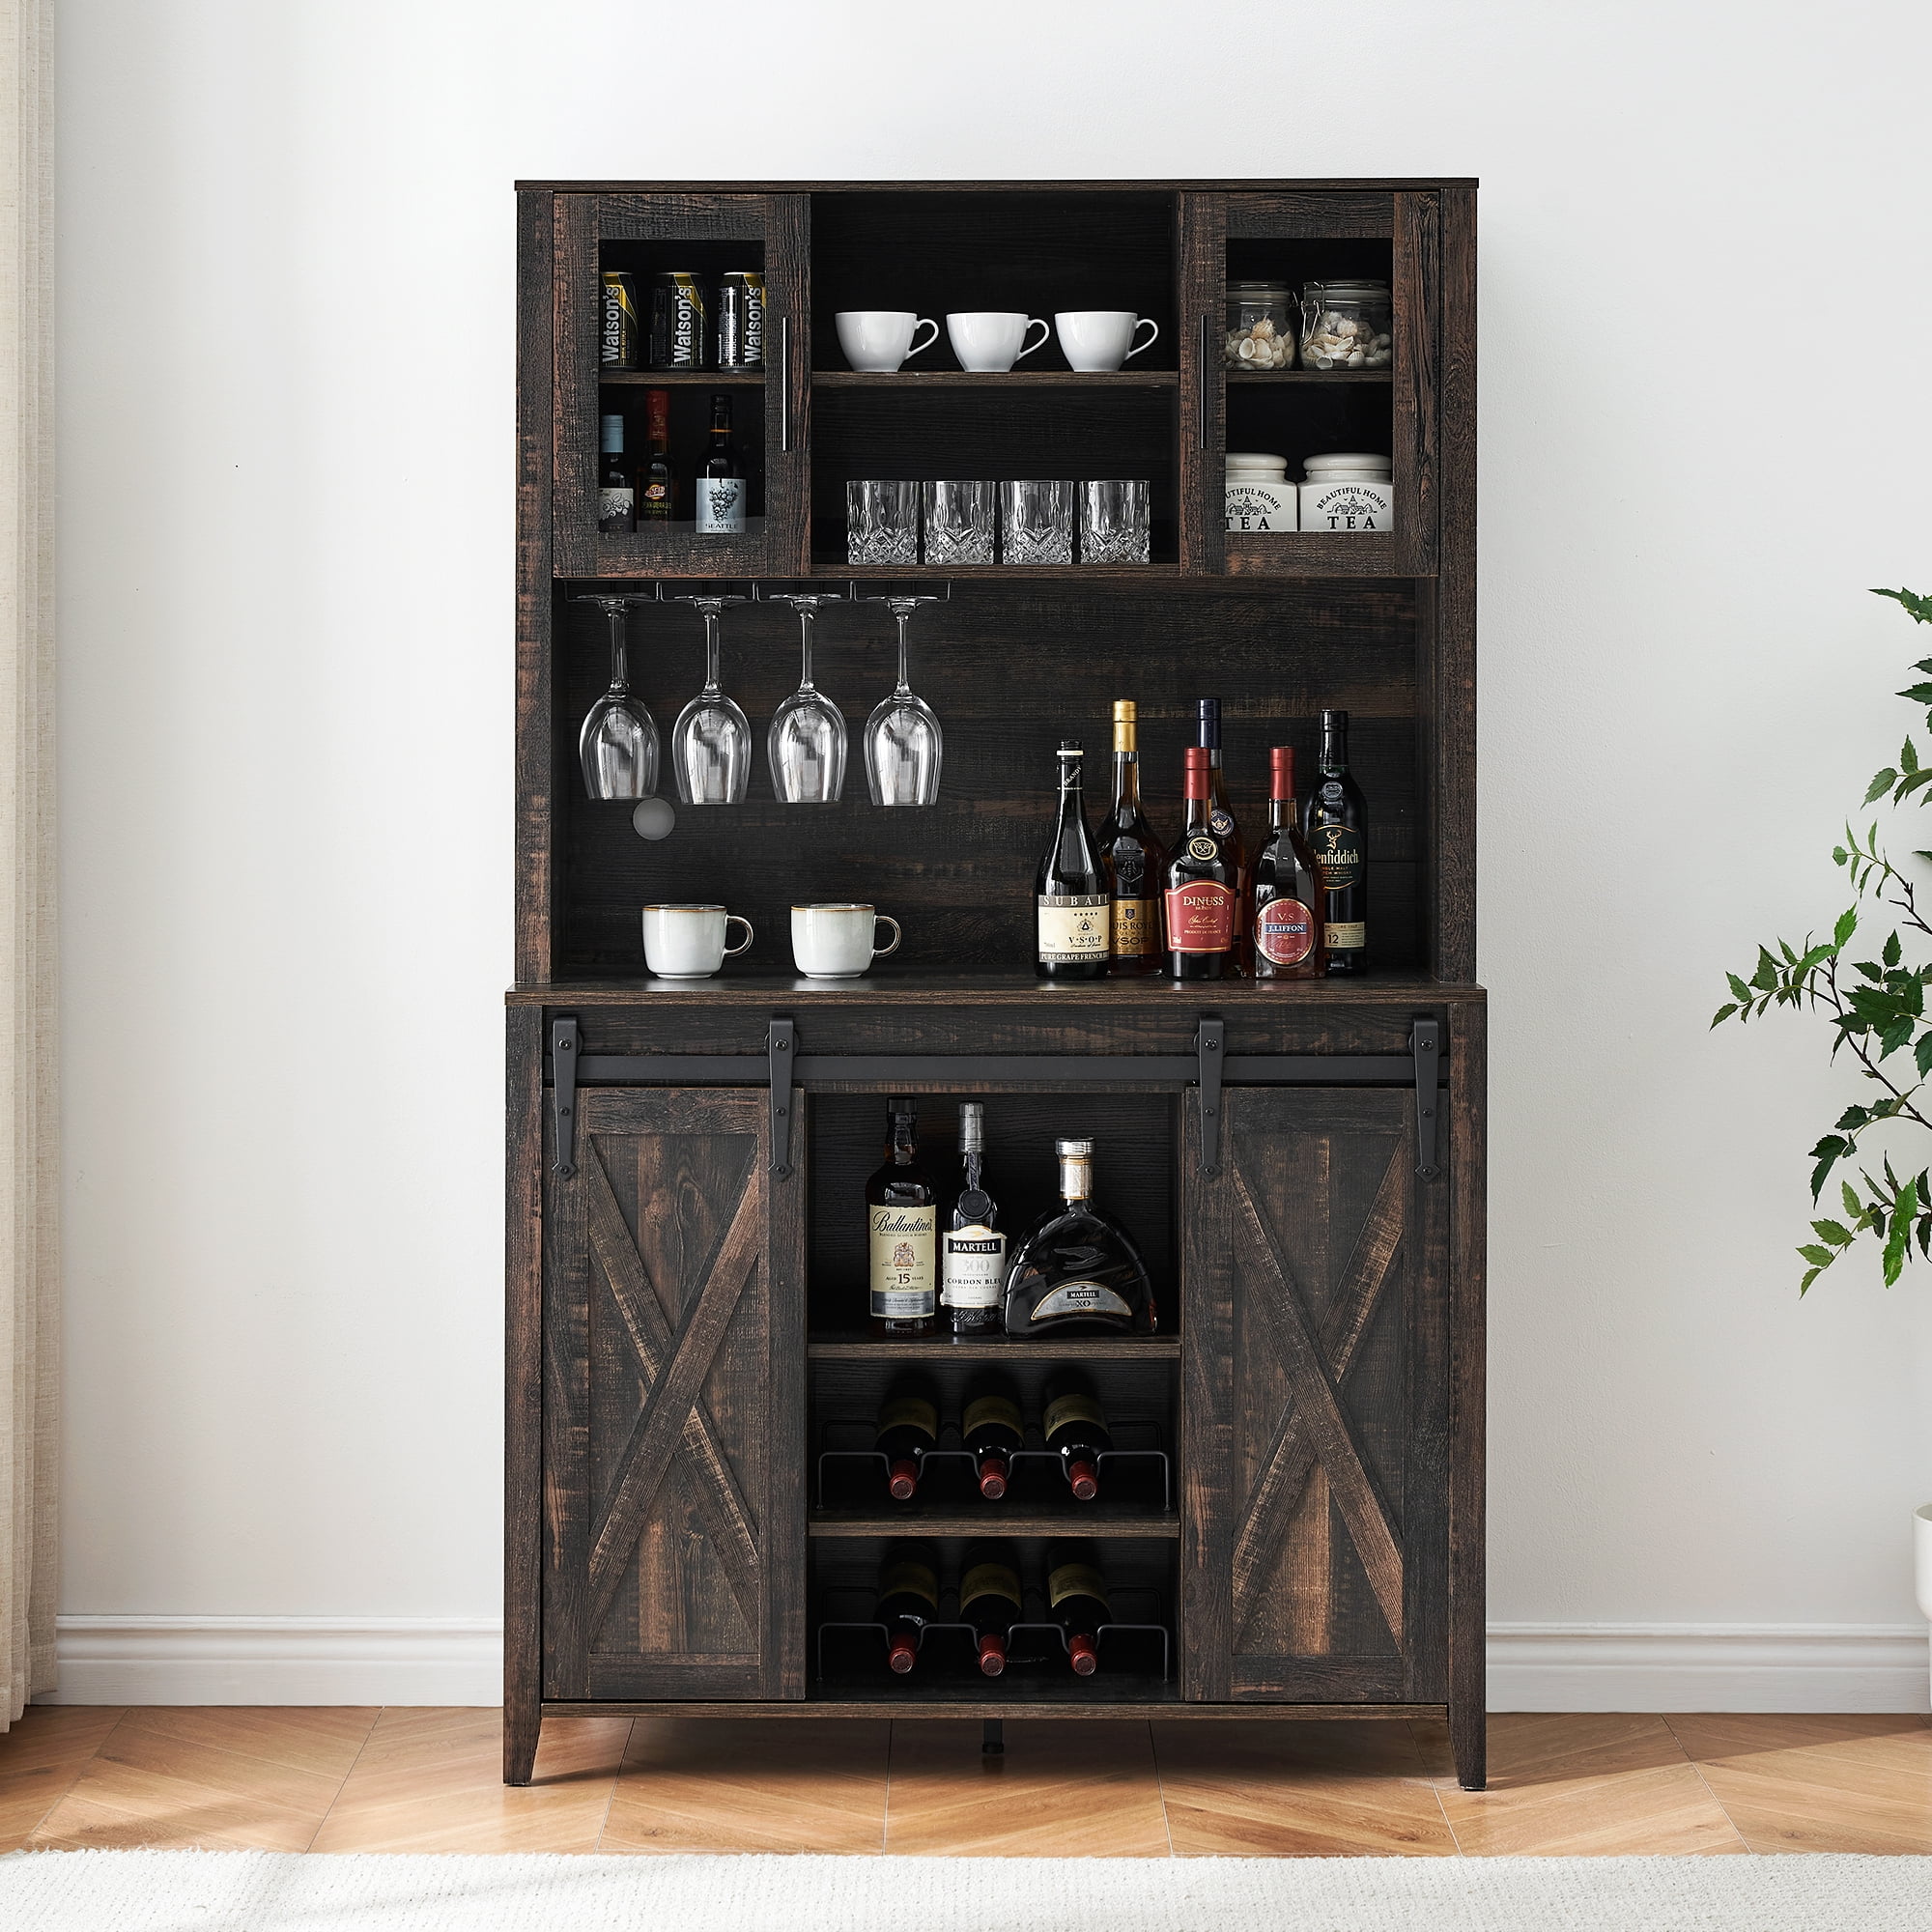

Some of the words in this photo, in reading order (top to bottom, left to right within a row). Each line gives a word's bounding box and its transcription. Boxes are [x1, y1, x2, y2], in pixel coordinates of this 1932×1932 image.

[602, 287, 620, 363] Watson's
[673, 287, 692, 363] Watson's
[744, 287, 762, 363] Watson's
[1225, 488, 1256, 498] UTIFUL
[1257, 490, 1281, 510] HOME
[1317, 487, 1362, 510] BEAUTIFUL
[1363, 489, 1387, 510] HOME
[1327, 515, 1376, 529] TEA
[1314, 848, 1359, 865] enfiddich
[1327, 934, 1339, 944] 12
[952, 1242, 997, 1252] MARTELL
[897, 1273, 911, 1285] 15
